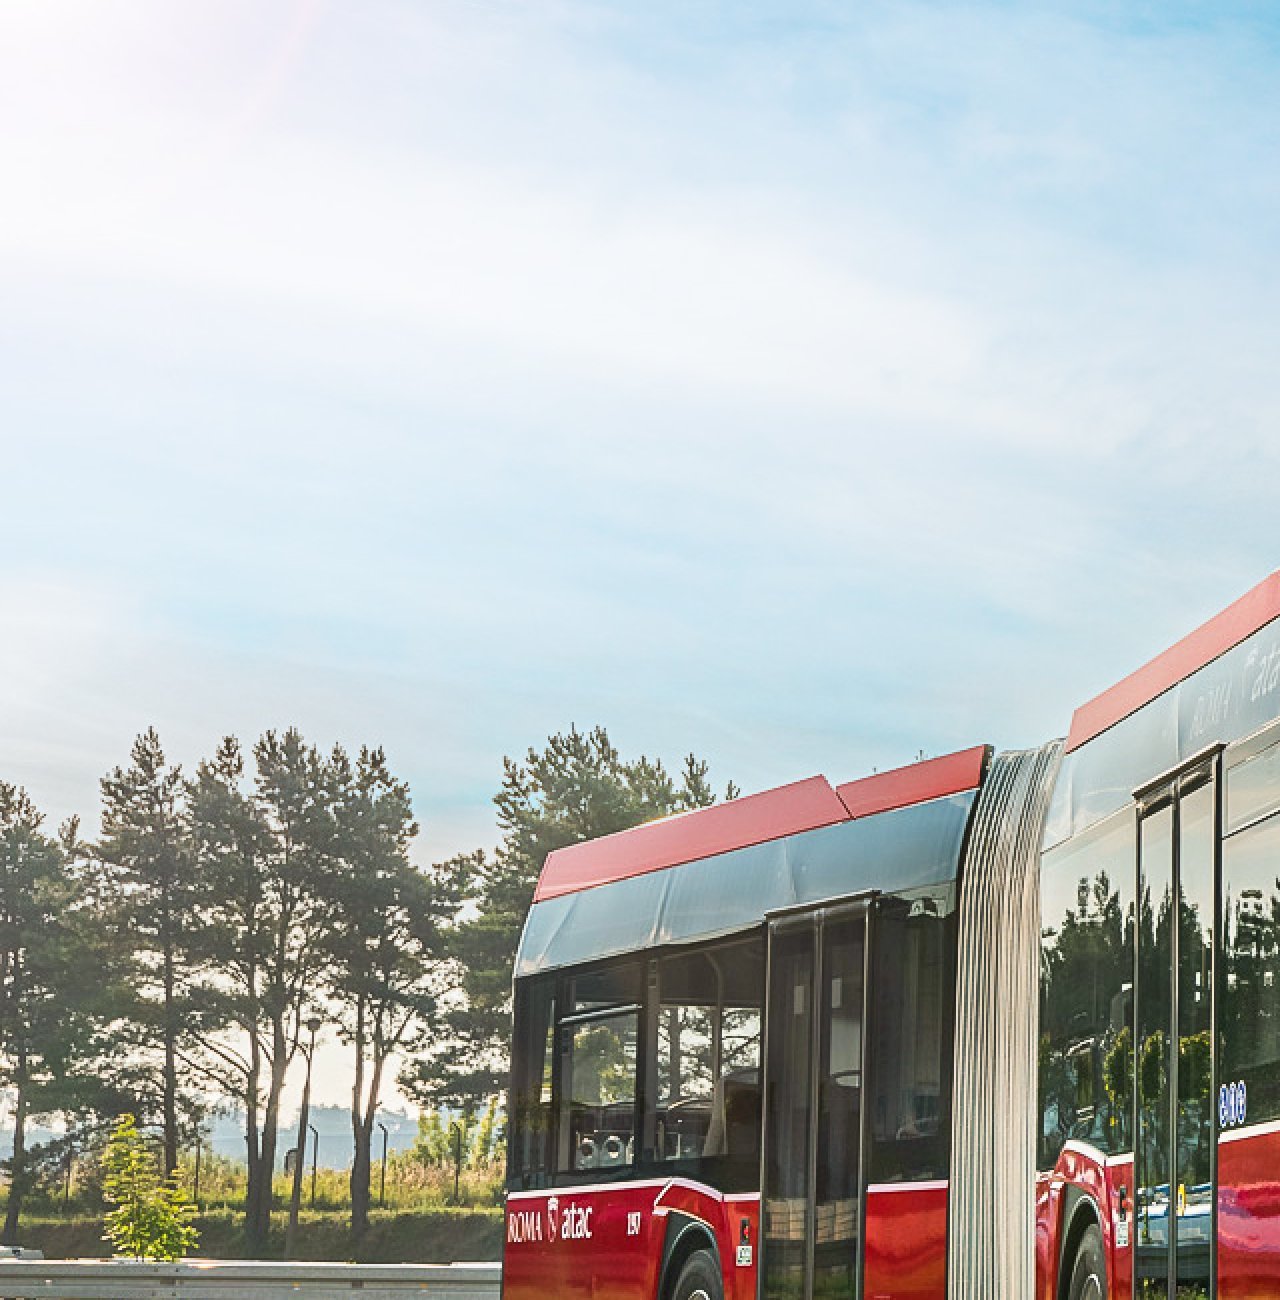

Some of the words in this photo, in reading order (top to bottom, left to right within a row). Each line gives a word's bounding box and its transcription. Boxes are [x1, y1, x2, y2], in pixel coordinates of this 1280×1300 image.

[507, 1211, 543, 1243] ROMA
[561, 1201, 593, 1240] atac
[627, 1211, 641, 1237] 197
